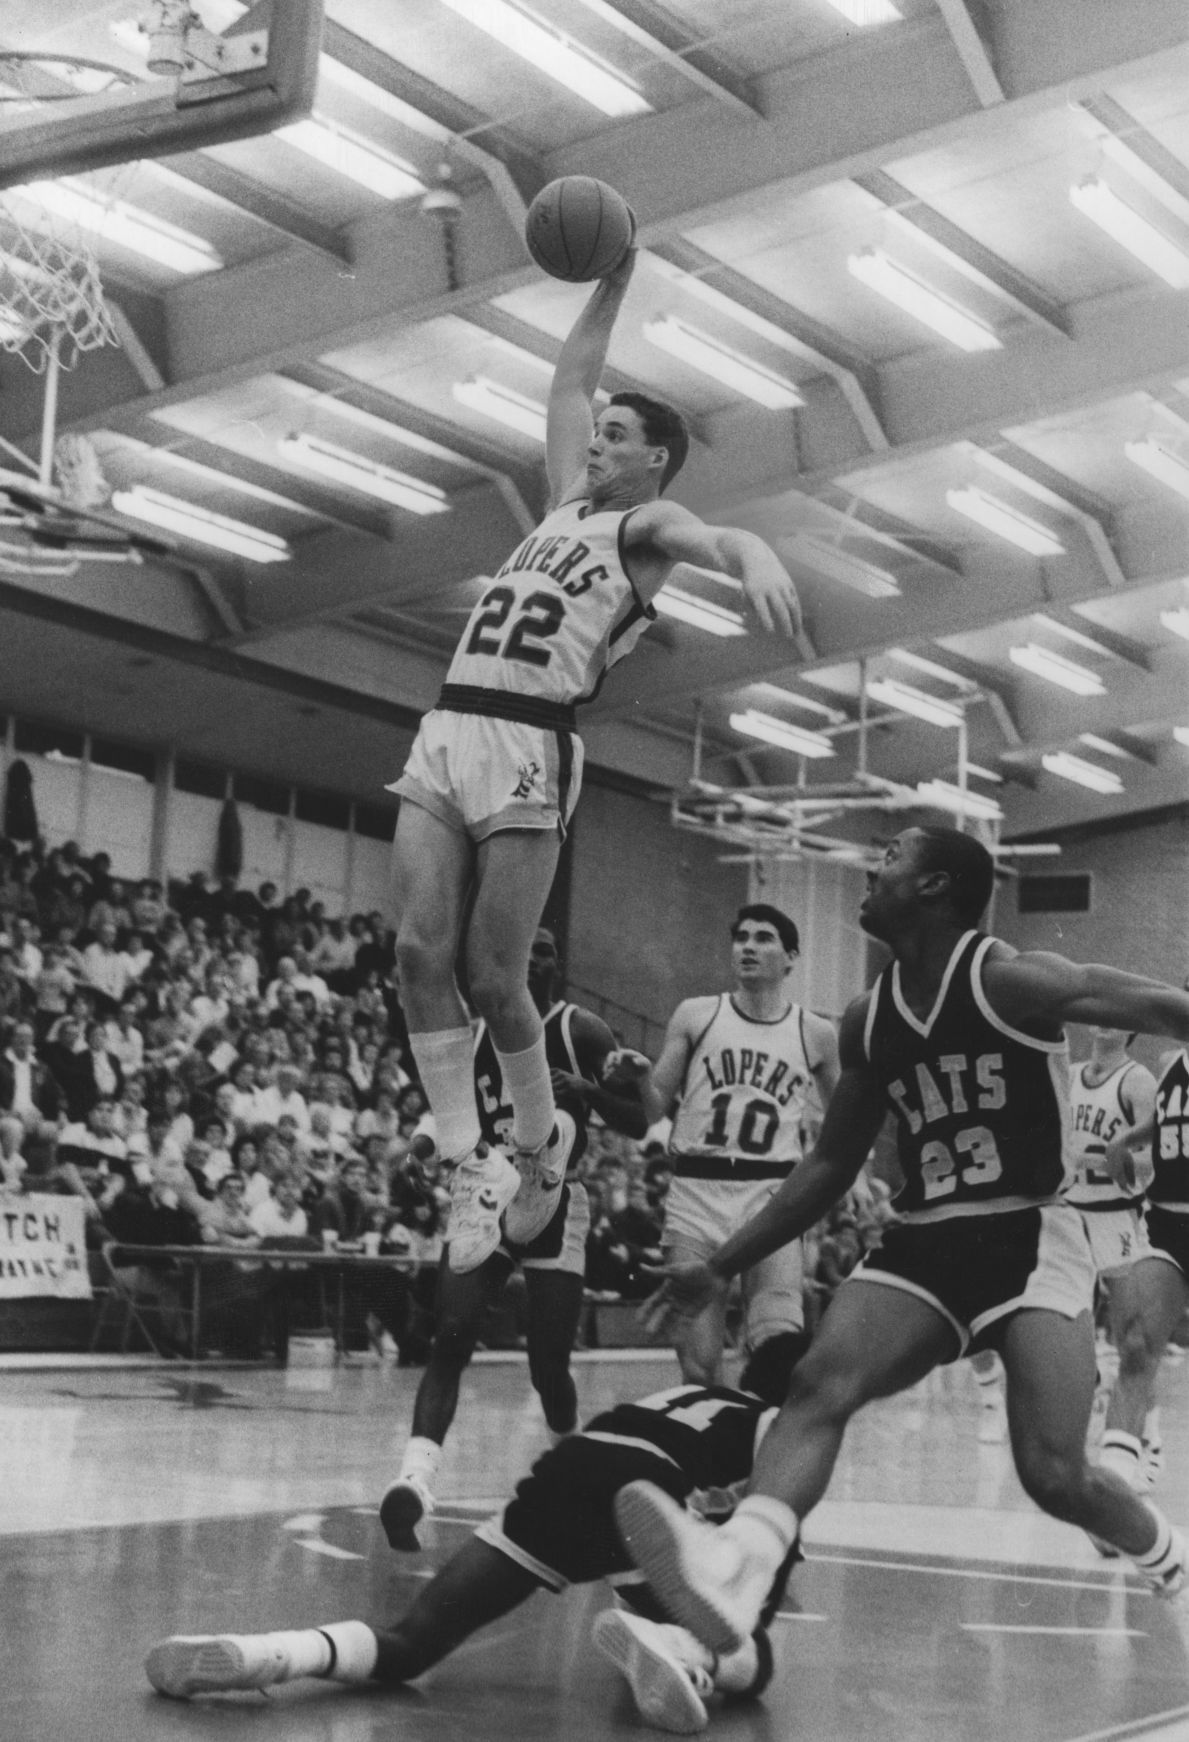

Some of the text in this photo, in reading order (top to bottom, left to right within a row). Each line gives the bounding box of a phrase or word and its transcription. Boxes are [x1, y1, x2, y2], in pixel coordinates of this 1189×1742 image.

[465, 585, 566, 668] 22
[703, 1048, 803, 1106] LOPERS
[888, 1053, 1007, 1135] CATS
[704, 1093, 780, 1155] 10
[1071, 1104, 1122, 1142] PERS
[921, 1126, 1003, 1200] 23
